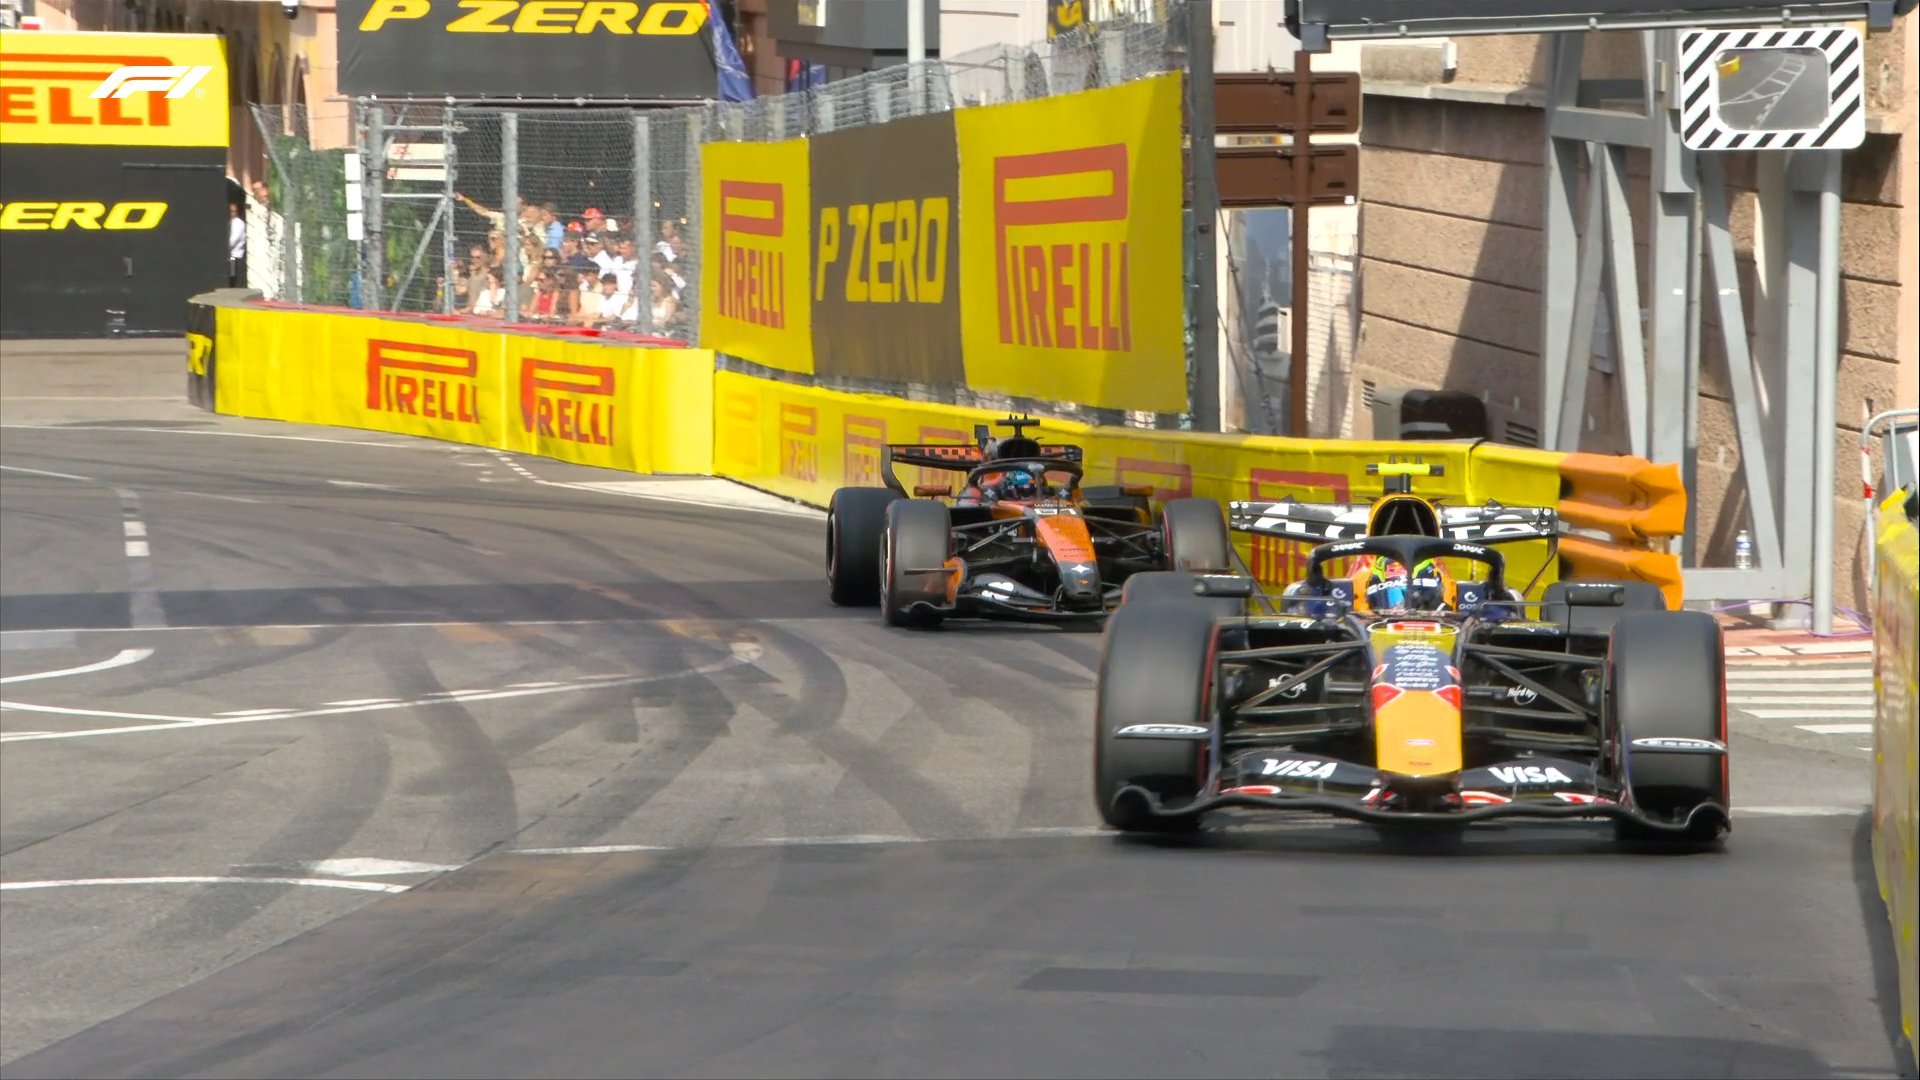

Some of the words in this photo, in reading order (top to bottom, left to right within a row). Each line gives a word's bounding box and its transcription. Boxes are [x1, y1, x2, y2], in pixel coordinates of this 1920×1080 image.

[359, 0, 430, 31] P
[446, 0, 709, 34] ZERO
[0, 53, 174, 126] ELLI
[0, 202, 168, 229] ERO
[816, 207, 840, 301] P
[846, 197, 949, 303] ZERO
[994, 143, 1131, 352] PIRELLI
[718, 180, 784, 329] PIRELLI
[367, 339, 480, 424] PIRELLI
[520, 358, 615, 447] PRELLI
[1378, 576, 1422, 590] ORACE
[1262, 759, 1337, 779] VISA
[1488, 766, 1572, 784] VISA
